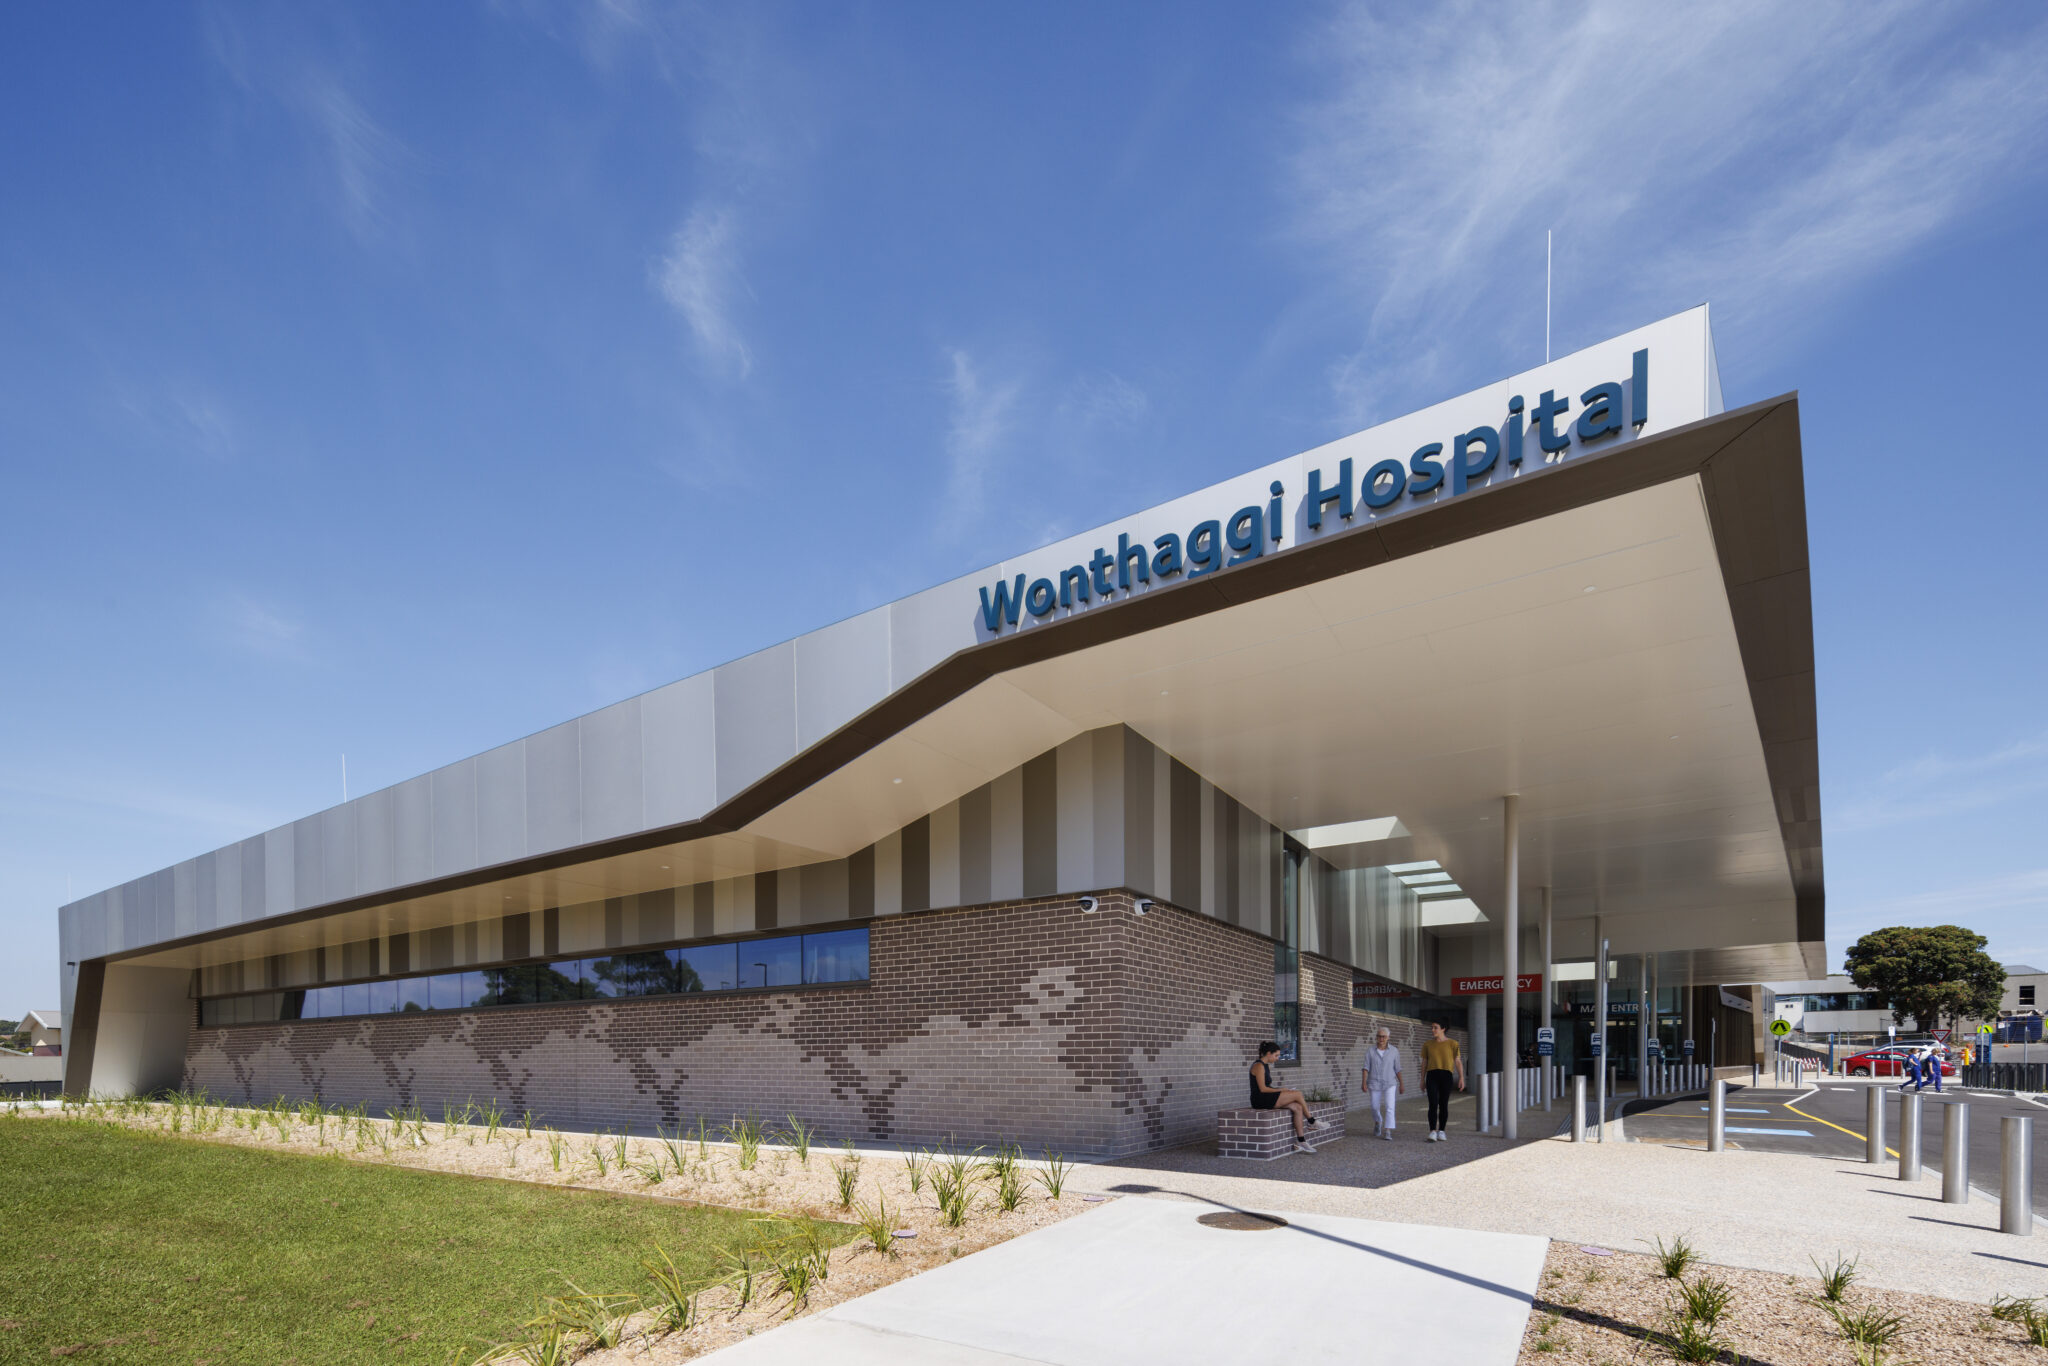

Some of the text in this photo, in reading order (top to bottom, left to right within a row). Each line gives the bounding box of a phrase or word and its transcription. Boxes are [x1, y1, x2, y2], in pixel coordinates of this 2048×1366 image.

[979, 347, 1649, 632] Wonthaggi Hospital
[1459, 978, 1533, 991] EMERGECY
[1580, 1003, 1646, 1013] MA ENTR
